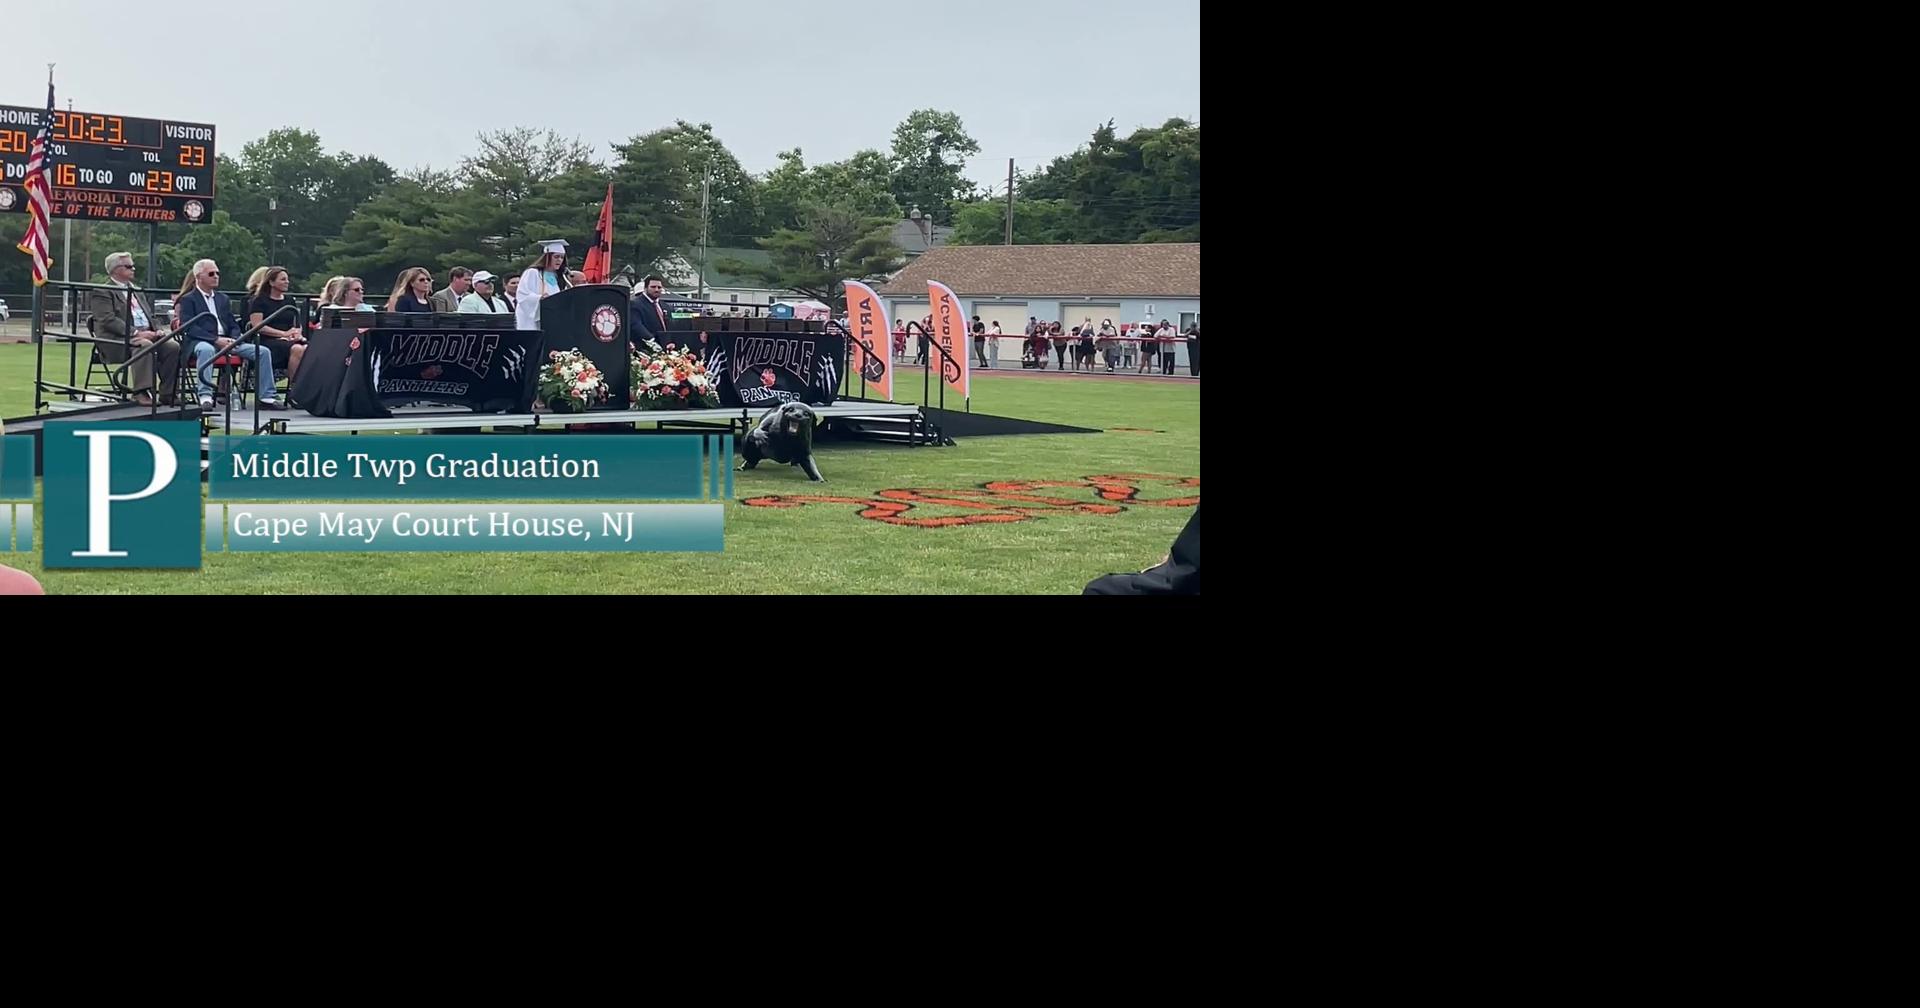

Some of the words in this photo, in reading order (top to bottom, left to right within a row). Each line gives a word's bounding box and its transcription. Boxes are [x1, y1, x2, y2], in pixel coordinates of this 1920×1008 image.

[0, 110, 40, 126] HOME
[165, 124, 213, 141] VISITOR
[51, 143, 68, 156] OL
[143, 151, 161, 163] TOL
[179, 144, 205, 167] 23
[79, 168, 94, 184] TO
[96, 169, 113, 185] GO
[129, 172, 145, 187] ON
[147, 170, 172, 192] 23
[175, 175, 197, 192] QTR
[123, 194, 163, 207] FIELD
[66, 203, 82, 215] OF
[87, 205, 110, 217] THE
[114, 207, 176, 221] PANTHERS
[382, 334, 500, 379] MIDDLE
[732, 336, 815, 388] MIDDLE
[379, 378, 470, 396] PANTHERS
